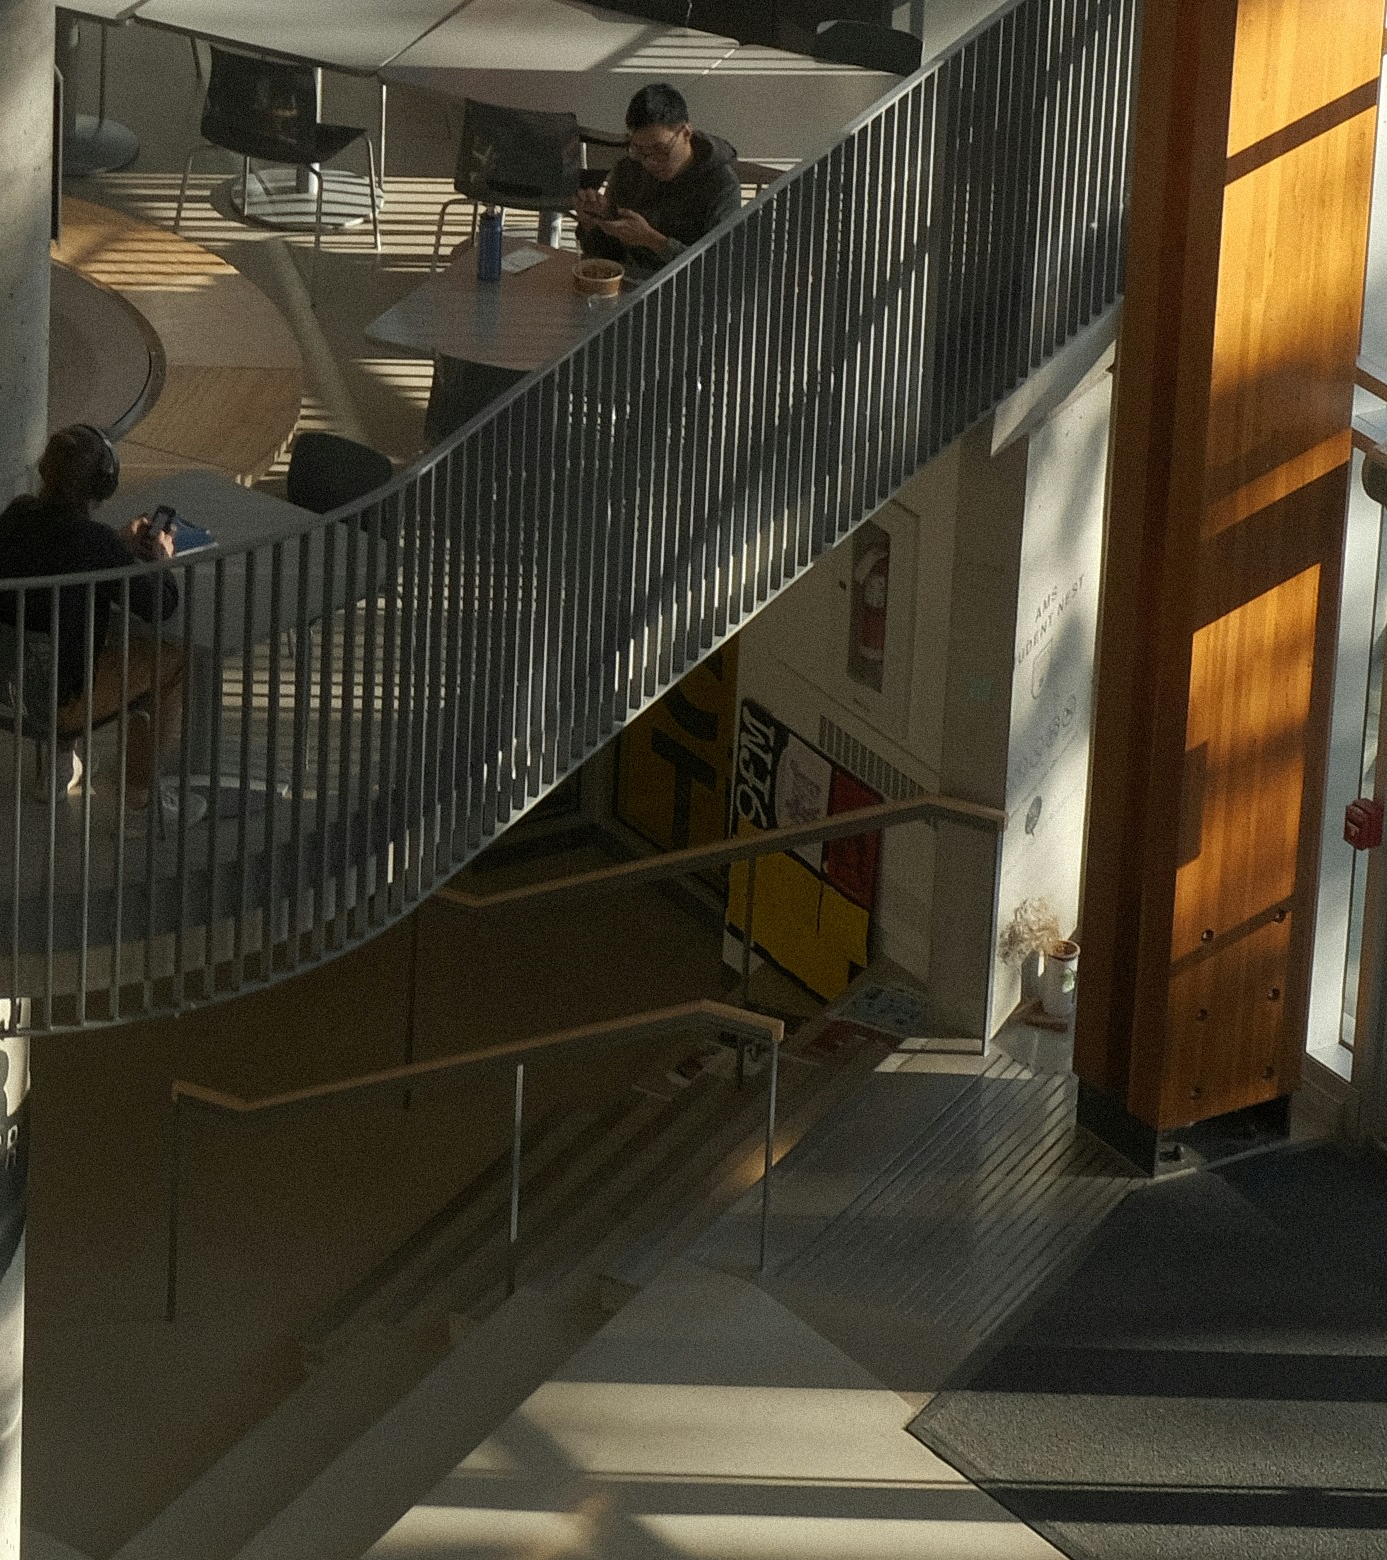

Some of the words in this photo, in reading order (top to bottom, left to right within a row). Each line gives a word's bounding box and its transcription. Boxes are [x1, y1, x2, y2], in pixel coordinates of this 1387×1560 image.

[1017, 612, 1053, 664] UDENT
[1056, 572, 1085, 617] NEST
[1034, 585, 1058, 623] AMS
